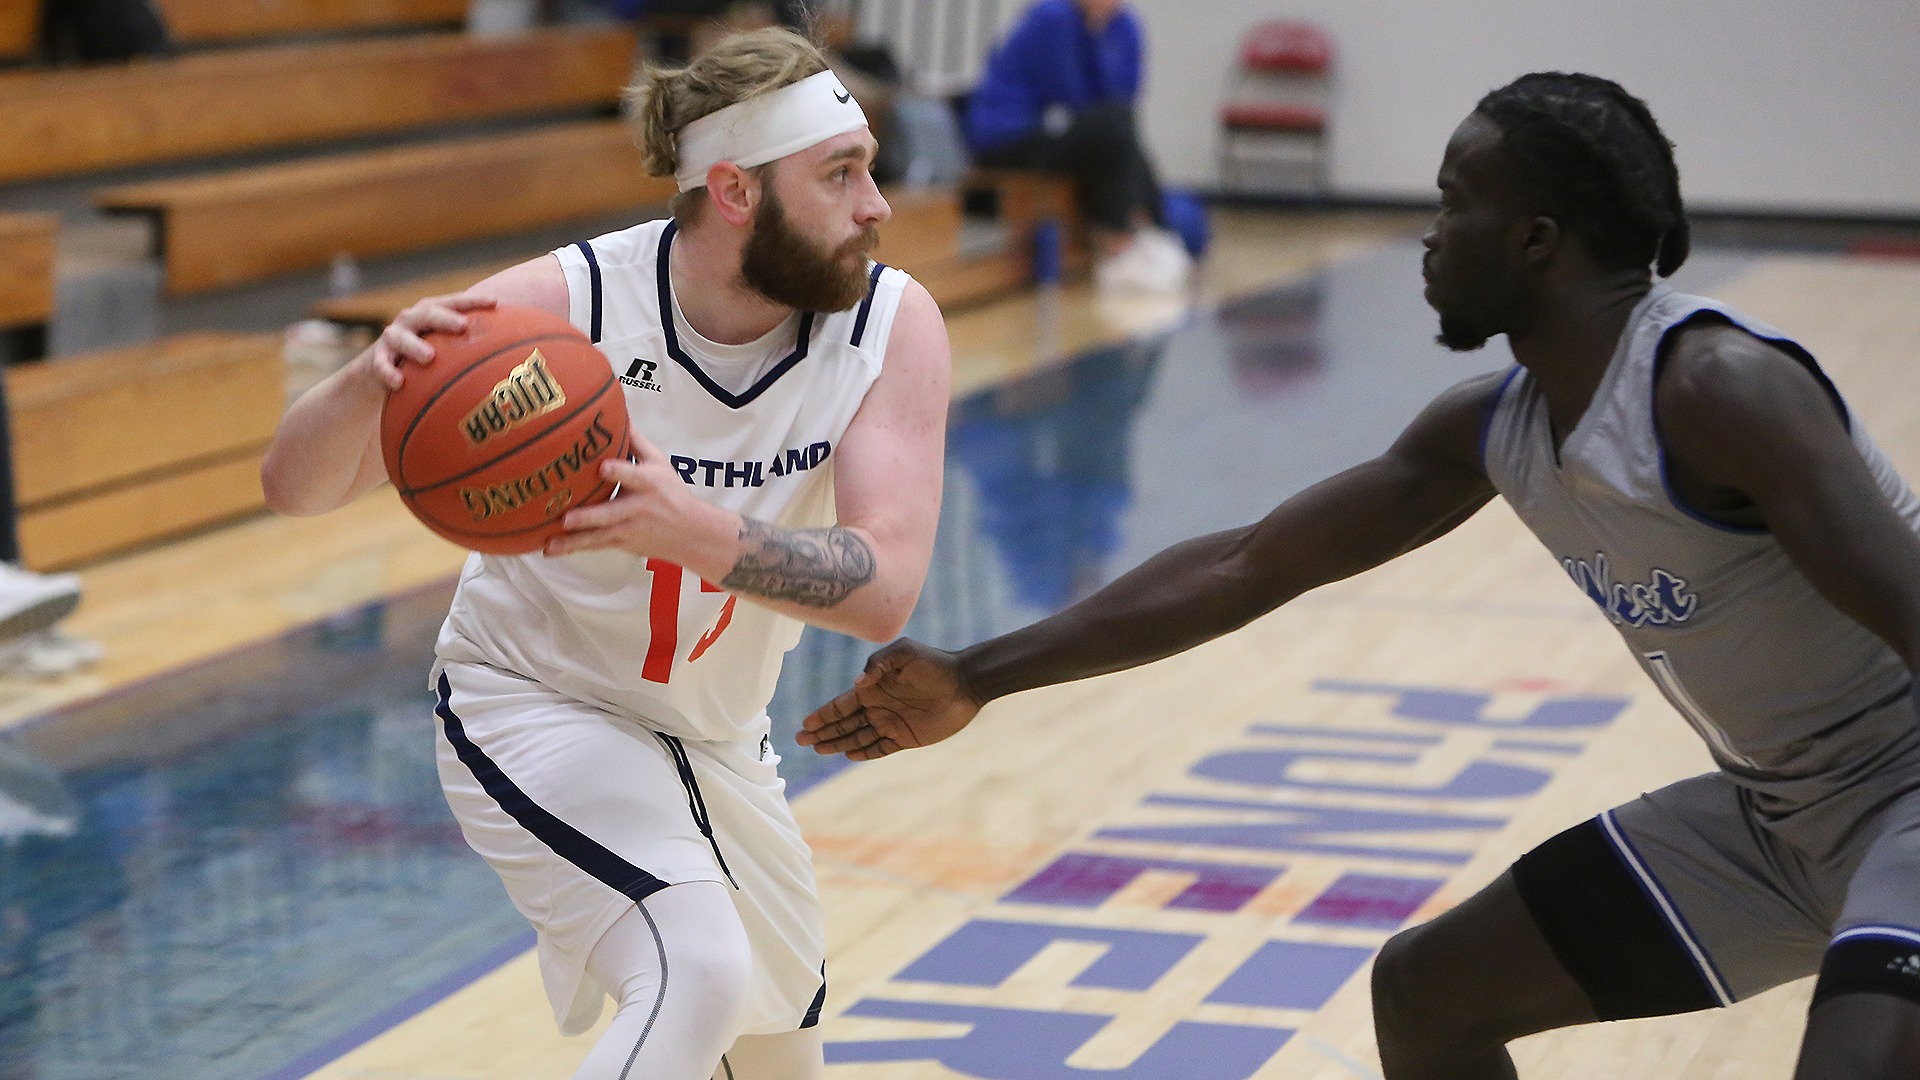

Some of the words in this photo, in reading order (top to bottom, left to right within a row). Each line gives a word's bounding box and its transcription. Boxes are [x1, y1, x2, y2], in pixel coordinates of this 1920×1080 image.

[463, 354, 561, 443] NJCAA
[619, 375, 662, 393] RUSSELL
[460, 412, 613, 523] SPALDING
[669, 439, 832, 488] RTHLAND
[822, 678, 1635, 1080] PIONEER
